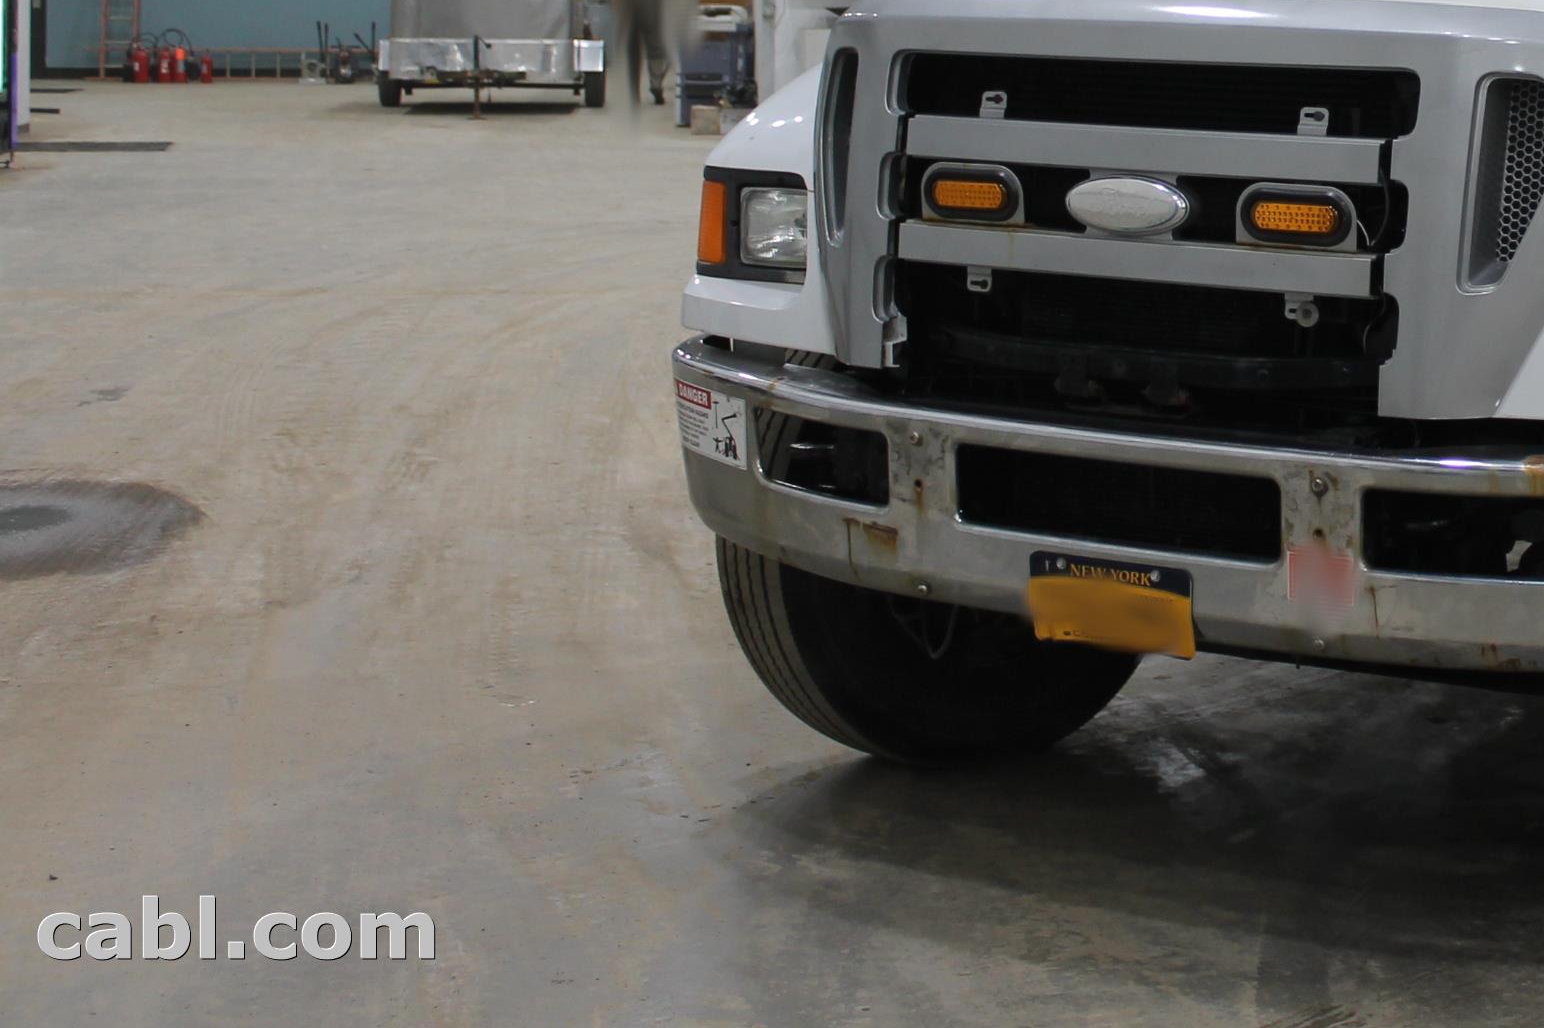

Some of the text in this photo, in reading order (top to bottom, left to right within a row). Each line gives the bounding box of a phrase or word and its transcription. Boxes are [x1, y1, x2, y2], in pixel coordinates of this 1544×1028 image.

[678, 383, 709, 406] DANGER
[1070, 563, 1151, 587] NEW YORK
